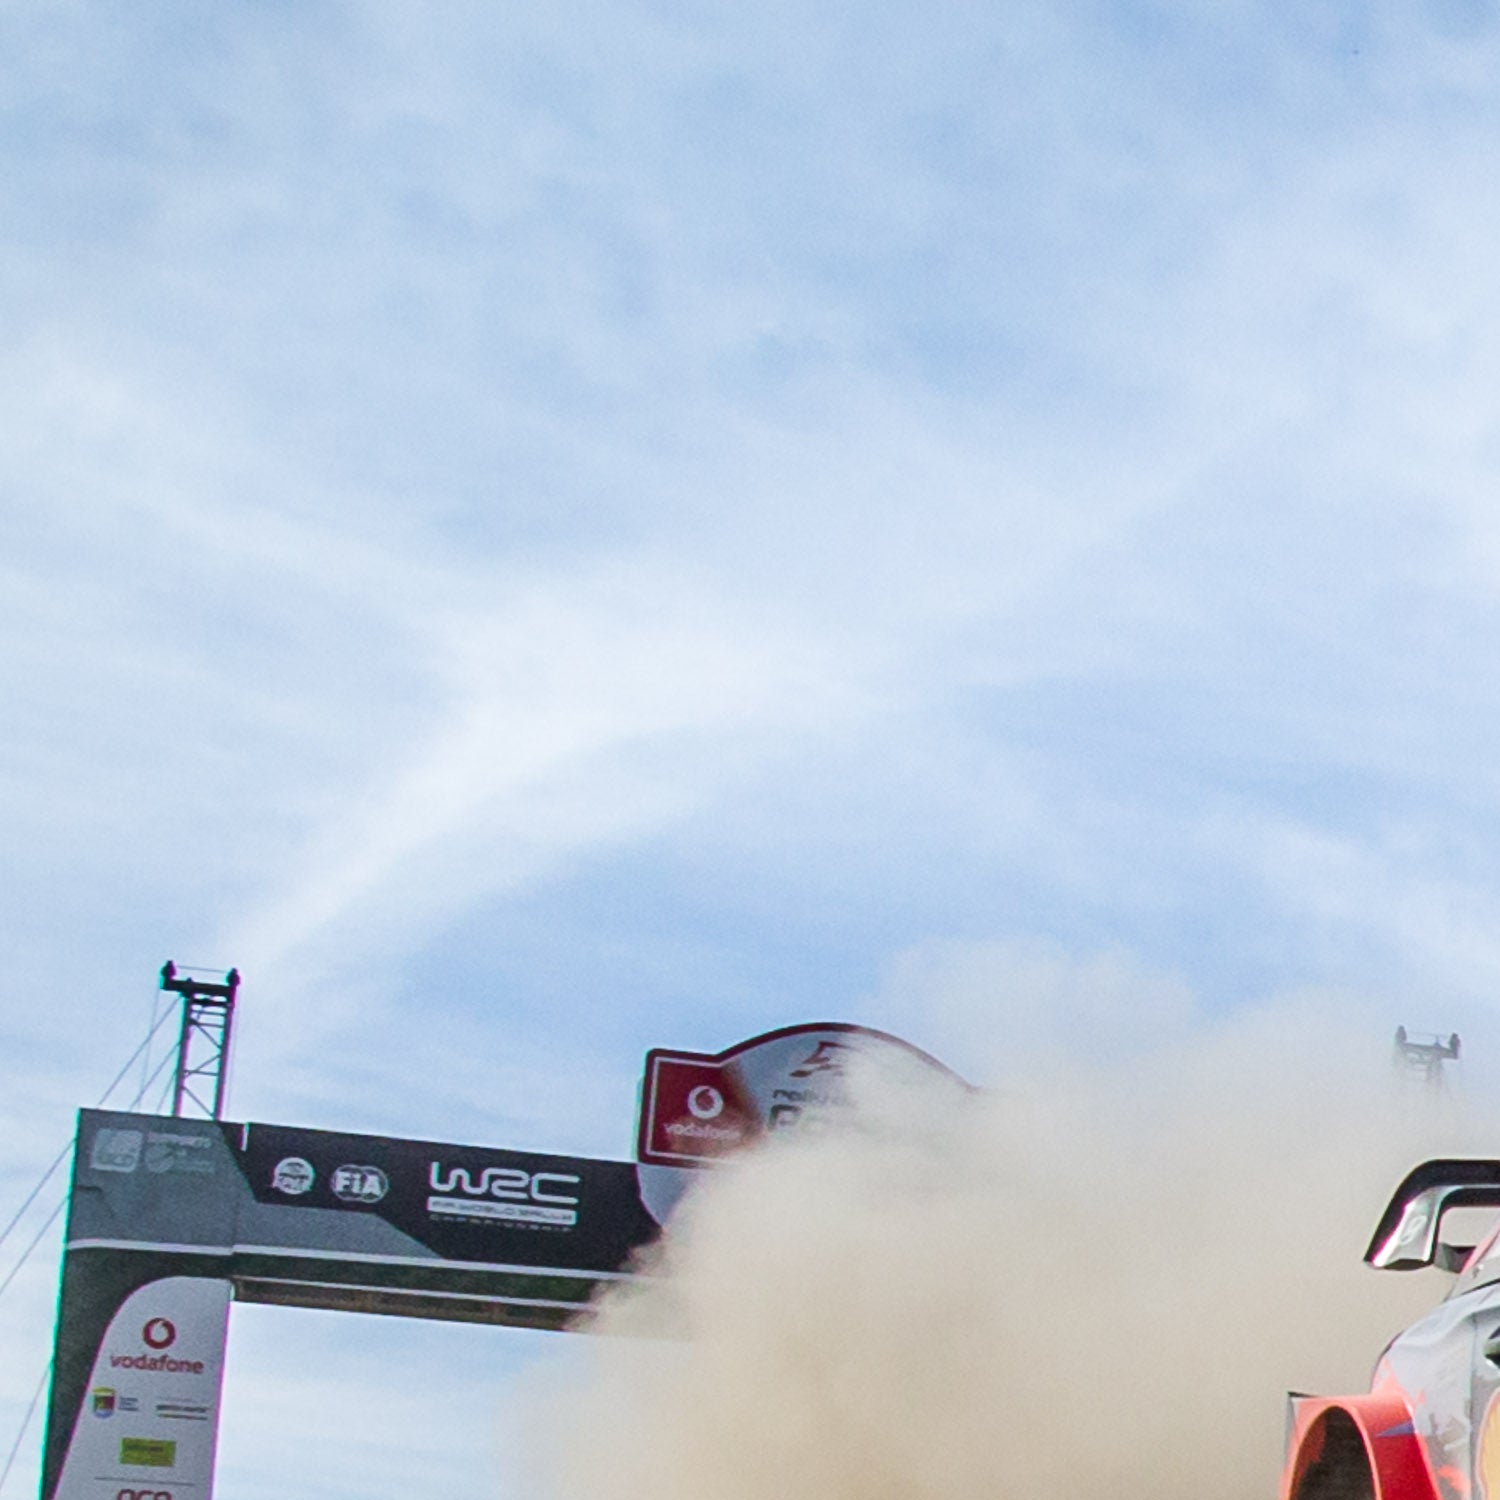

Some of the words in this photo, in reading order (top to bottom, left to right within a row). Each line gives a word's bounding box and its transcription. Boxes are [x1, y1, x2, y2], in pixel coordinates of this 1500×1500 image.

[336, 1170, 381, 1196] FIA
[429, 1161, 581, 1205] WRC
[110, 1354, 205, 1375] vodafone
